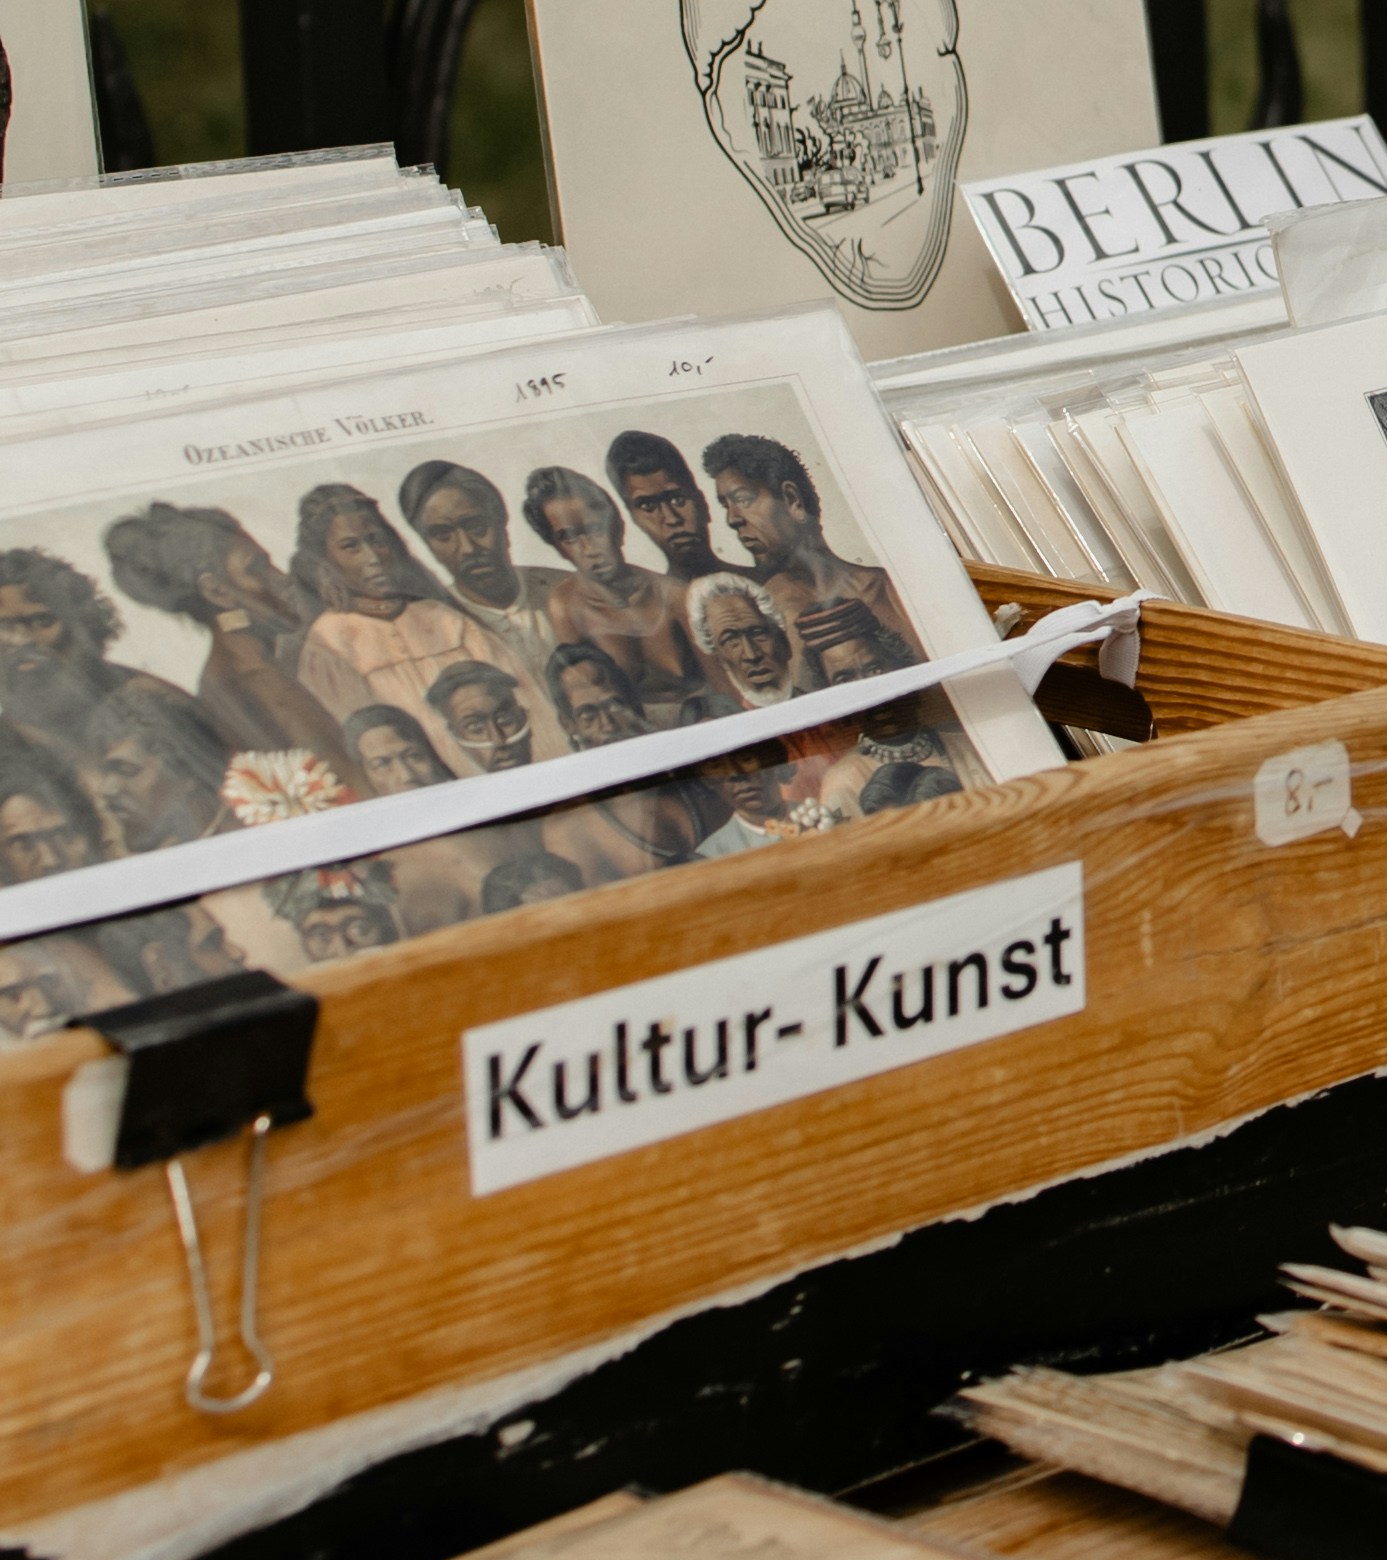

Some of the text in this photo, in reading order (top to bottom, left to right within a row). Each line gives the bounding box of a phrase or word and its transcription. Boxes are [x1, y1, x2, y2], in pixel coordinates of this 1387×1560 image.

[515, 372, 567, 403] 1895
[484, 916, 1073, 1141] Kultur- Kunst
